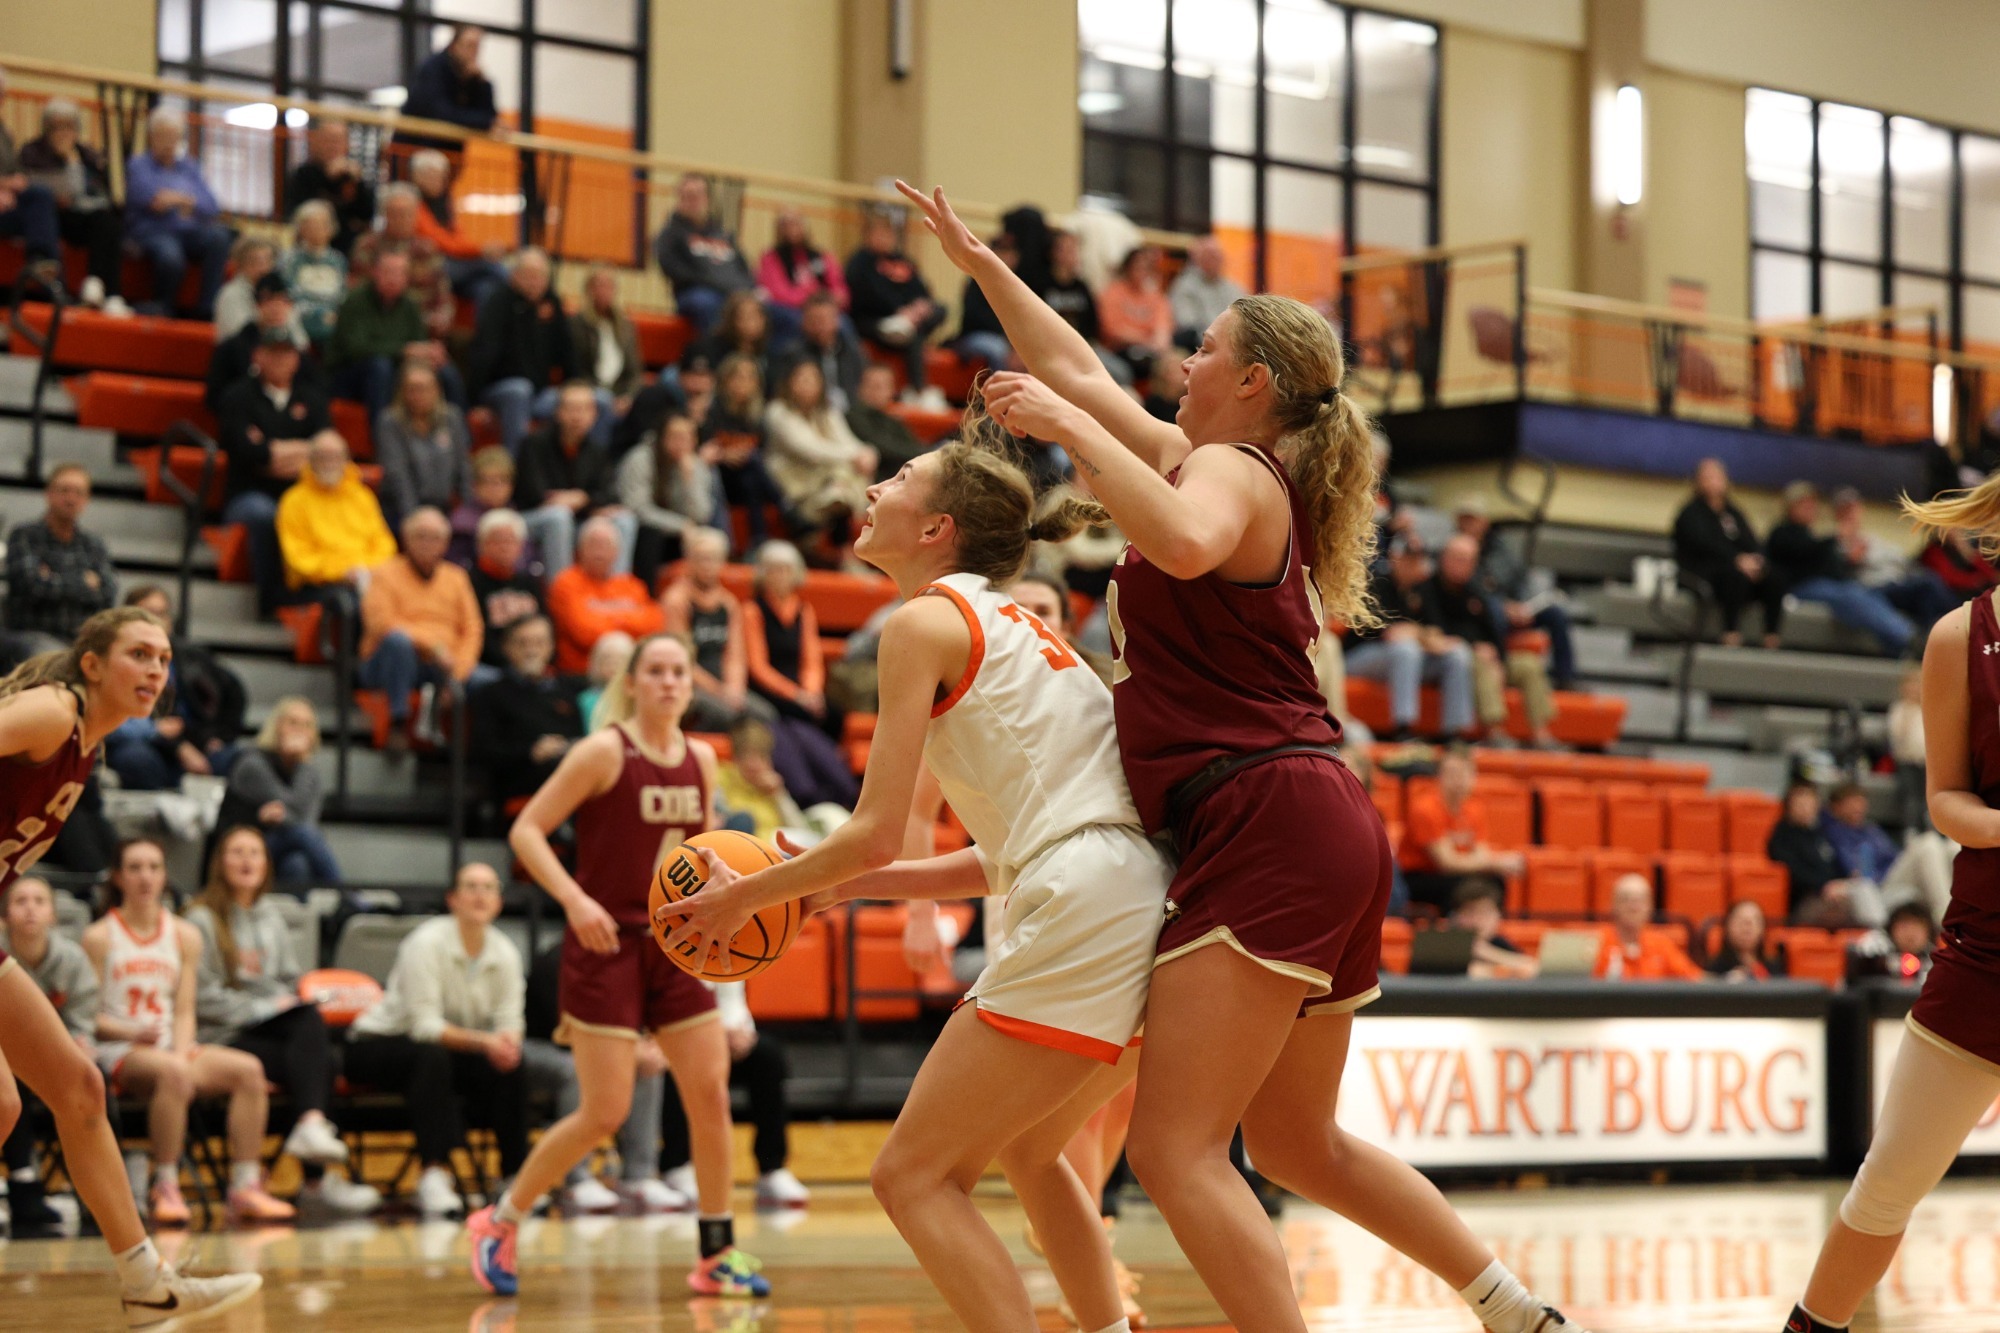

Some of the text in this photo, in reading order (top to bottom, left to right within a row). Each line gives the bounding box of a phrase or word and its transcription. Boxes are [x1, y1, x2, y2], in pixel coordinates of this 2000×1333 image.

[998, 603, 1078, 671] 3
[667, 854, 707, 897] Wil
[1362, 1046, 1809, 1138] WARTBURG
